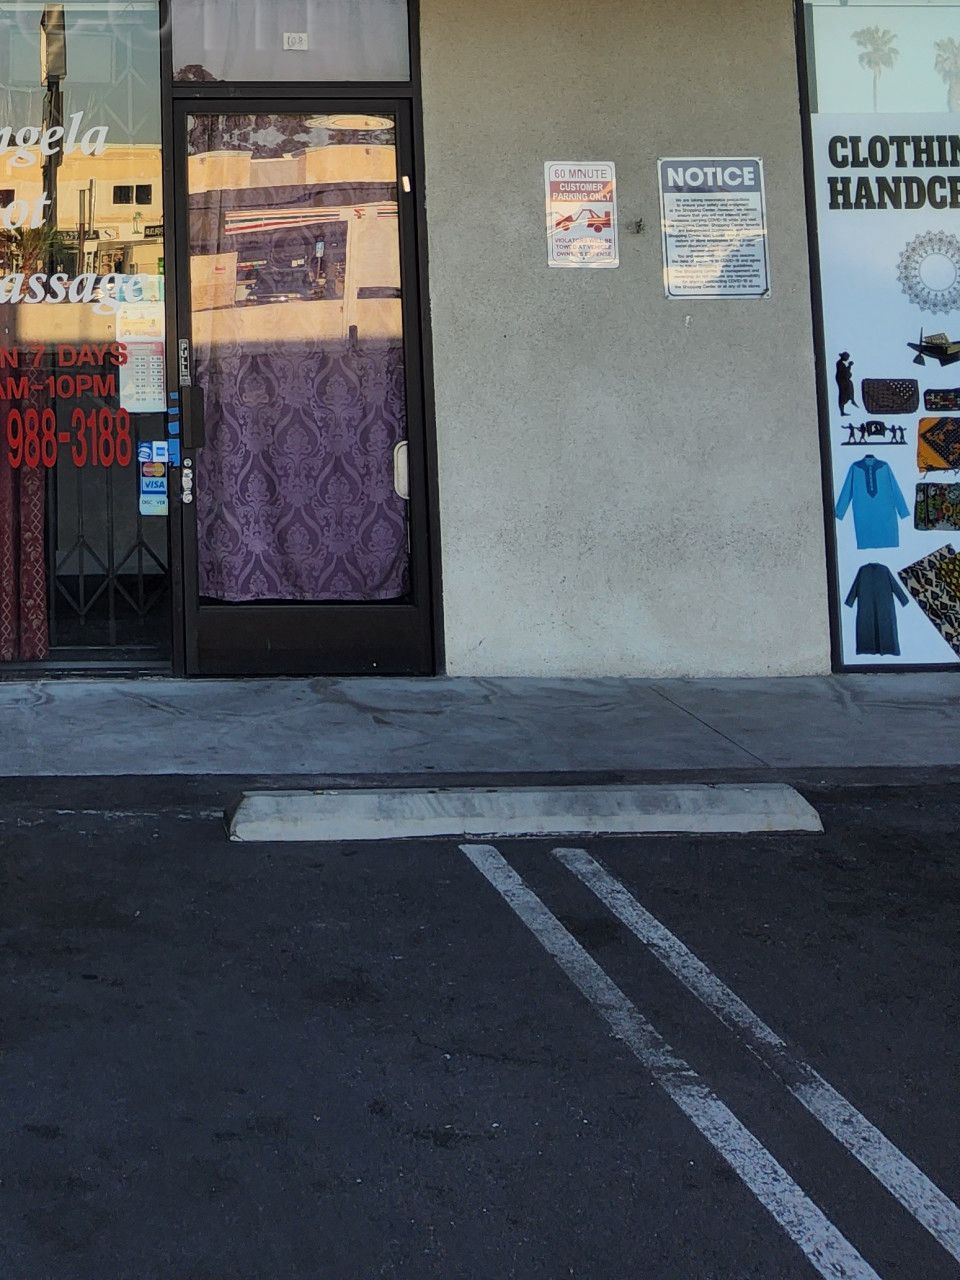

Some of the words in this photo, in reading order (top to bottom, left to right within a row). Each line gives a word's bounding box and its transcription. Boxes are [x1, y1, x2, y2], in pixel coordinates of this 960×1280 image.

[554, 169, 565, 179] 60
[569, 169, 607, 179] MINUTE
[667, 166, 755, 187] NOTICE
[559, 183, 603, 191] CUSTOMER
[552, 193, 589, 201] PARKING
[590, 193, 611, 201] ONLY
[31, 344, 46, 367] 7
[58, 342, 129, 367] DAYS
[6, 407, 132, 469] 988-3188
[145, 480, 165, 489] VISA
